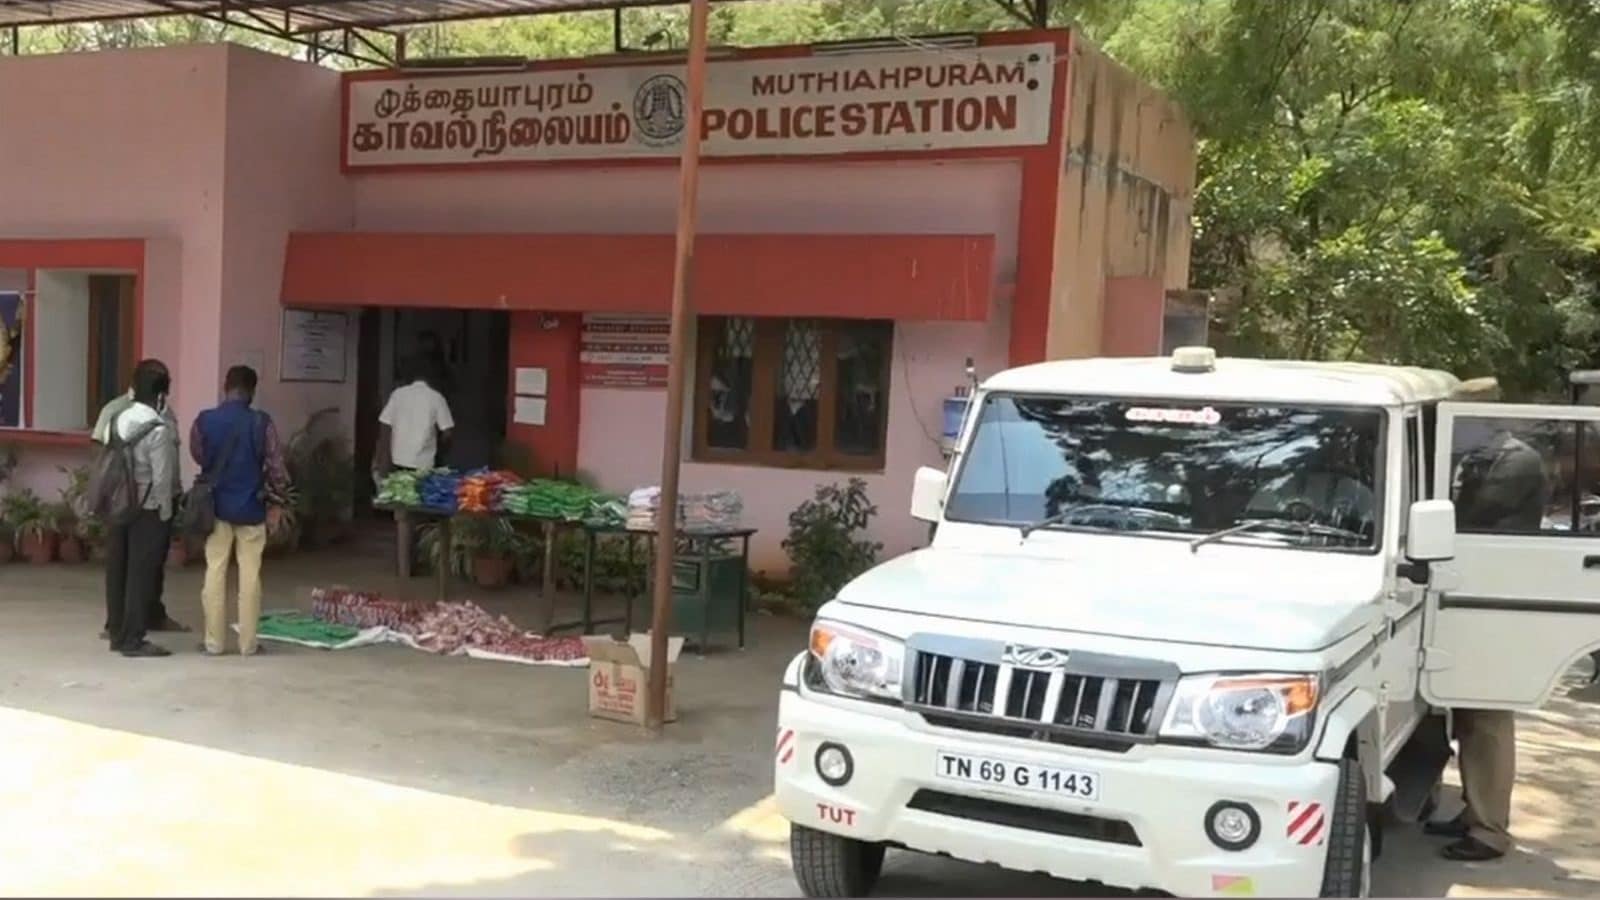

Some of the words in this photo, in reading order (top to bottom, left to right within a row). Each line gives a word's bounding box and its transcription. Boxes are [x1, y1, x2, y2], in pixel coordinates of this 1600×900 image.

[375, 73, 593, 119] முத்தையாபுரம்
[752, 63, 1025, 96] MUTHIAHPURAM
[943, 755, 972, 778] TN
[979, 760, 1006, 782] 69
[1013, 766, 1030, 786] G
[1038, 770, 1094, 796] 1143
[815, 803, 857, 826] TUT
